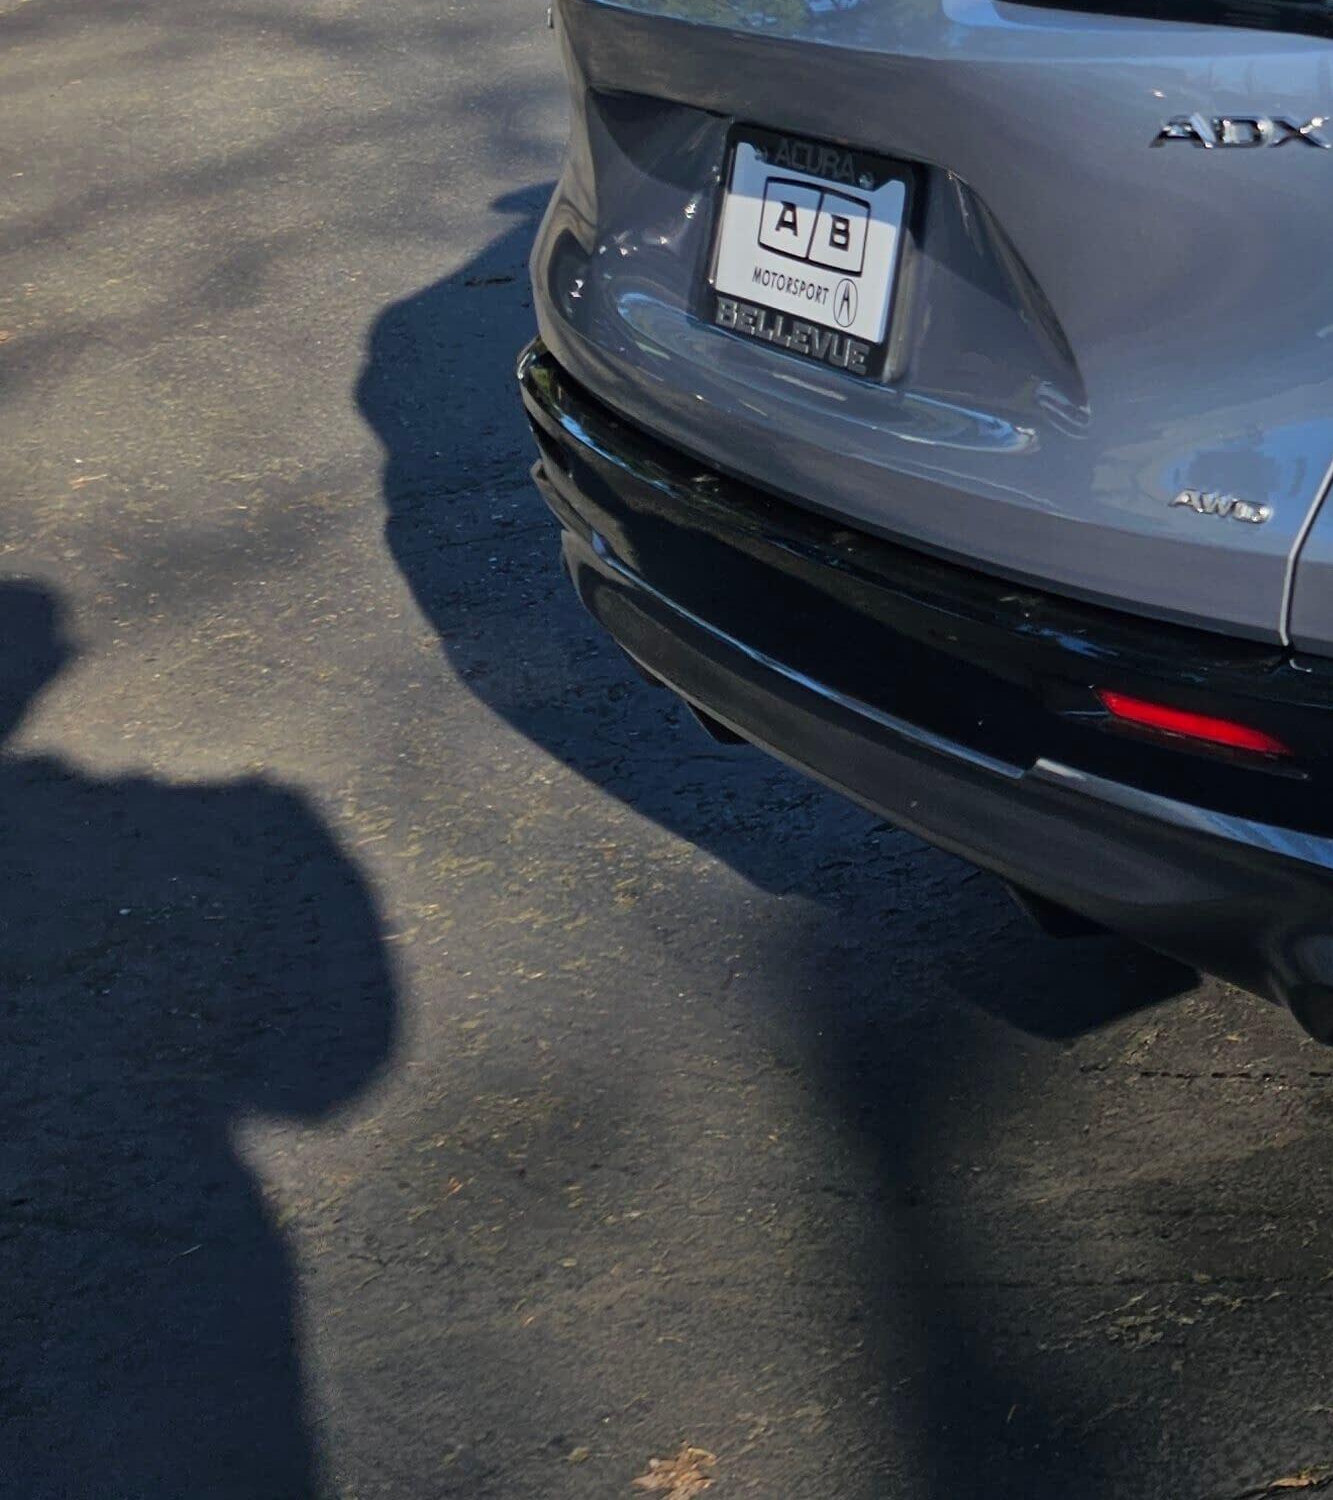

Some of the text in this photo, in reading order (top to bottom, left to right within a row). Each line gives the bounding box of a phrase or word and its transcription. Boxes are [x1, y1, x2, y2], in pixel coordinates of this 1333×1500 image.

[1148, 112, 1332, 149] ADX
[774, 140, 856, 179] ACURA
[752, 265, 830, 306] MOTORSPORT
[714, 301, 871, 376] BELLEVUE
[1168, 488, 1272, 524] AWD
